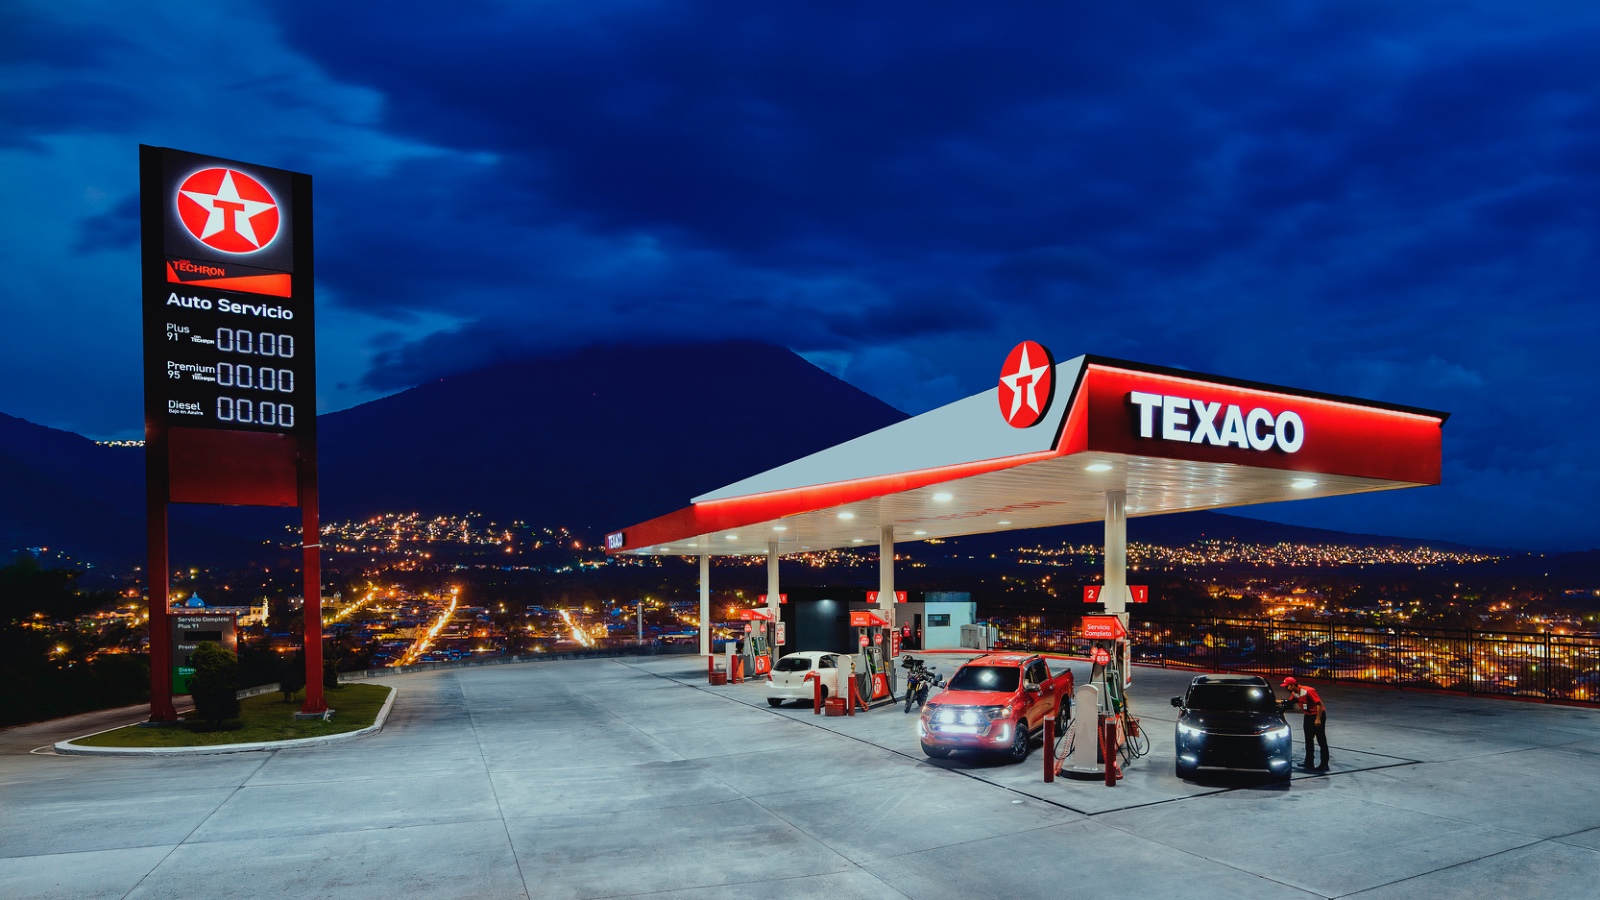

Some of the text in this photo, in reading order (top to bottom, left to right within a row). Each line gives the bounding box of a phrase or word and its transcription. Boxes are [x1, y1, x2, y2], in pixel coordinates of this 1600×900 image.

[172, 260, 225, 277] TECHRON
[166, 292, 294, 320] Auto Servicio
[166, 322, 190, 334] Plus
[166, 331, 178, 341] 91
[216, 327, 294, 358] 00.00
[167, 360, 216, 374] Premium
[167, 370, 181, 380] 95
[216, 362, 294, 393] 00.00
[168, 400, 201, 411] Diesel
[216, 396, 294, 427] 00.00
[1131, 391, 1304, 453] TEXACO
[1088, 590, 1094, 599] 2
[1139, 590, 1144, 599] 1
